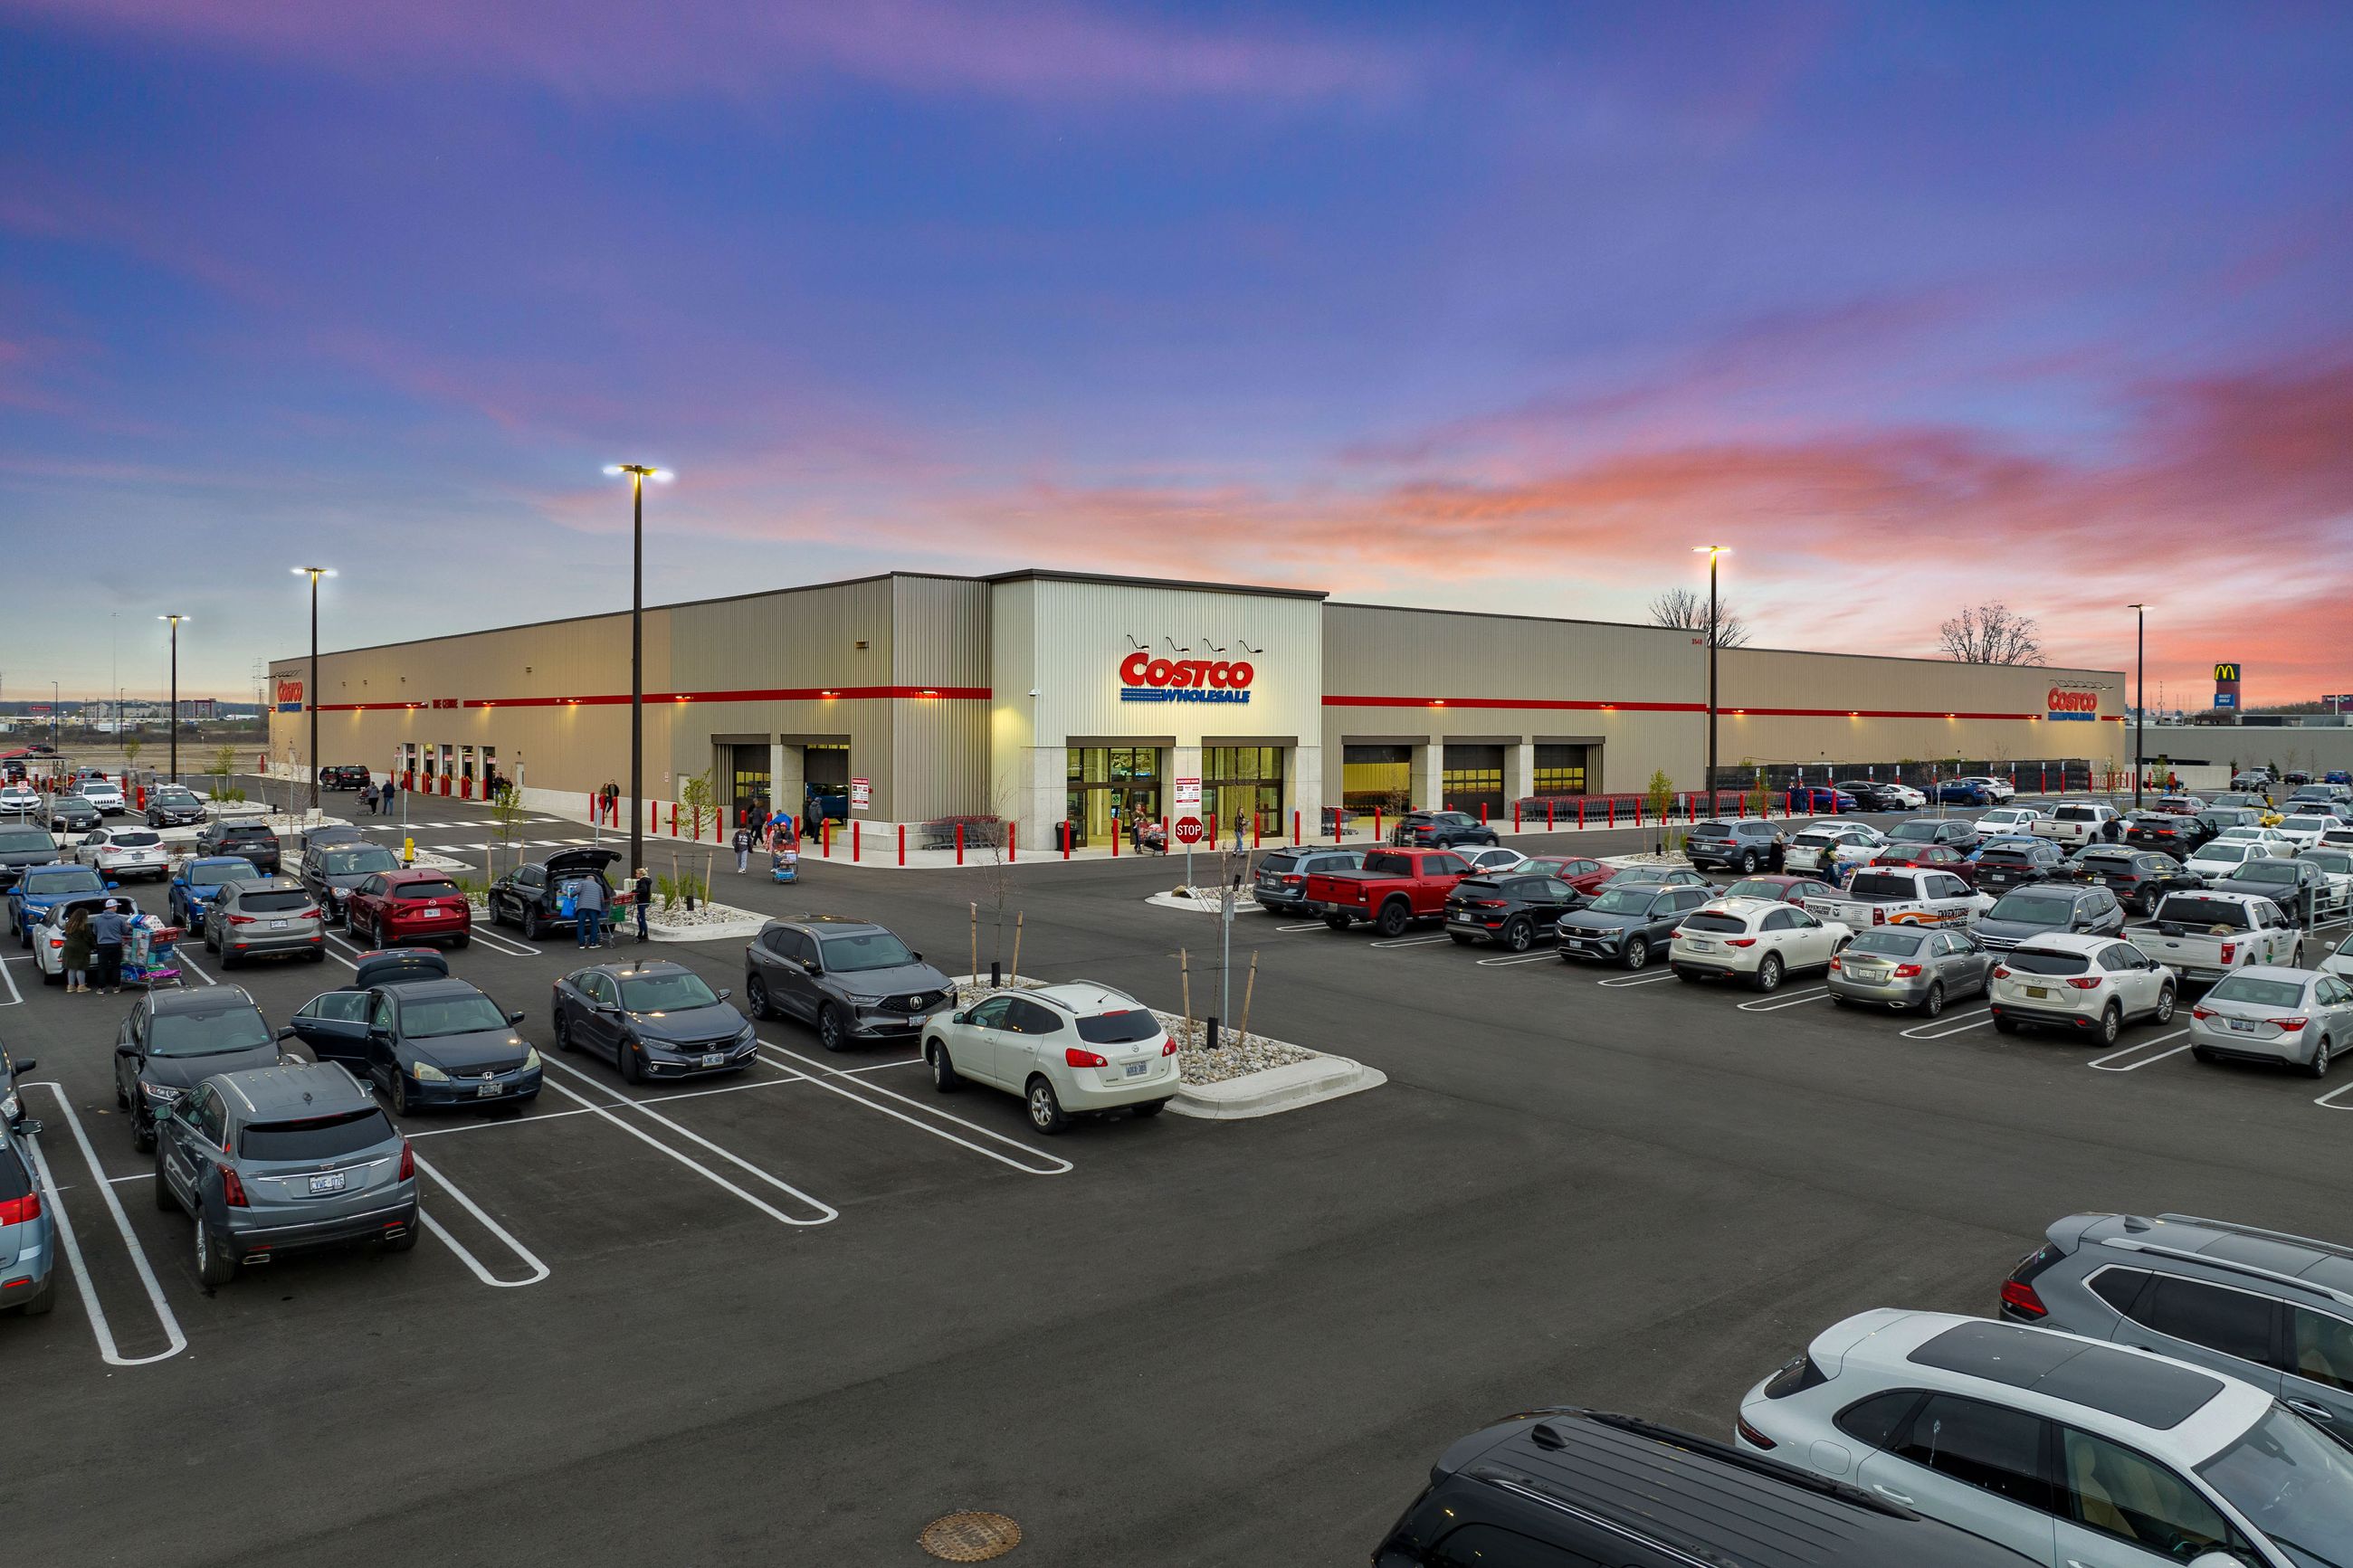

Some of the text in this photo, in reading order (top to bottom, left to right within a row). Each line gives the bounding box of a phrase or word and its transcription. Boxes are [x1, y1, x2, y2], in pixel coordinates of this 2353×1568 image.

[1119, 652, 1254, 689] COSTCO
[1162, 689, 1251, 703] WHOLESALE
[2048, 687, 2097, 711] COSTCO
[1176, 824, 1202, 836] STOP
[1938, 908, 1969, 920] INVENTORY
